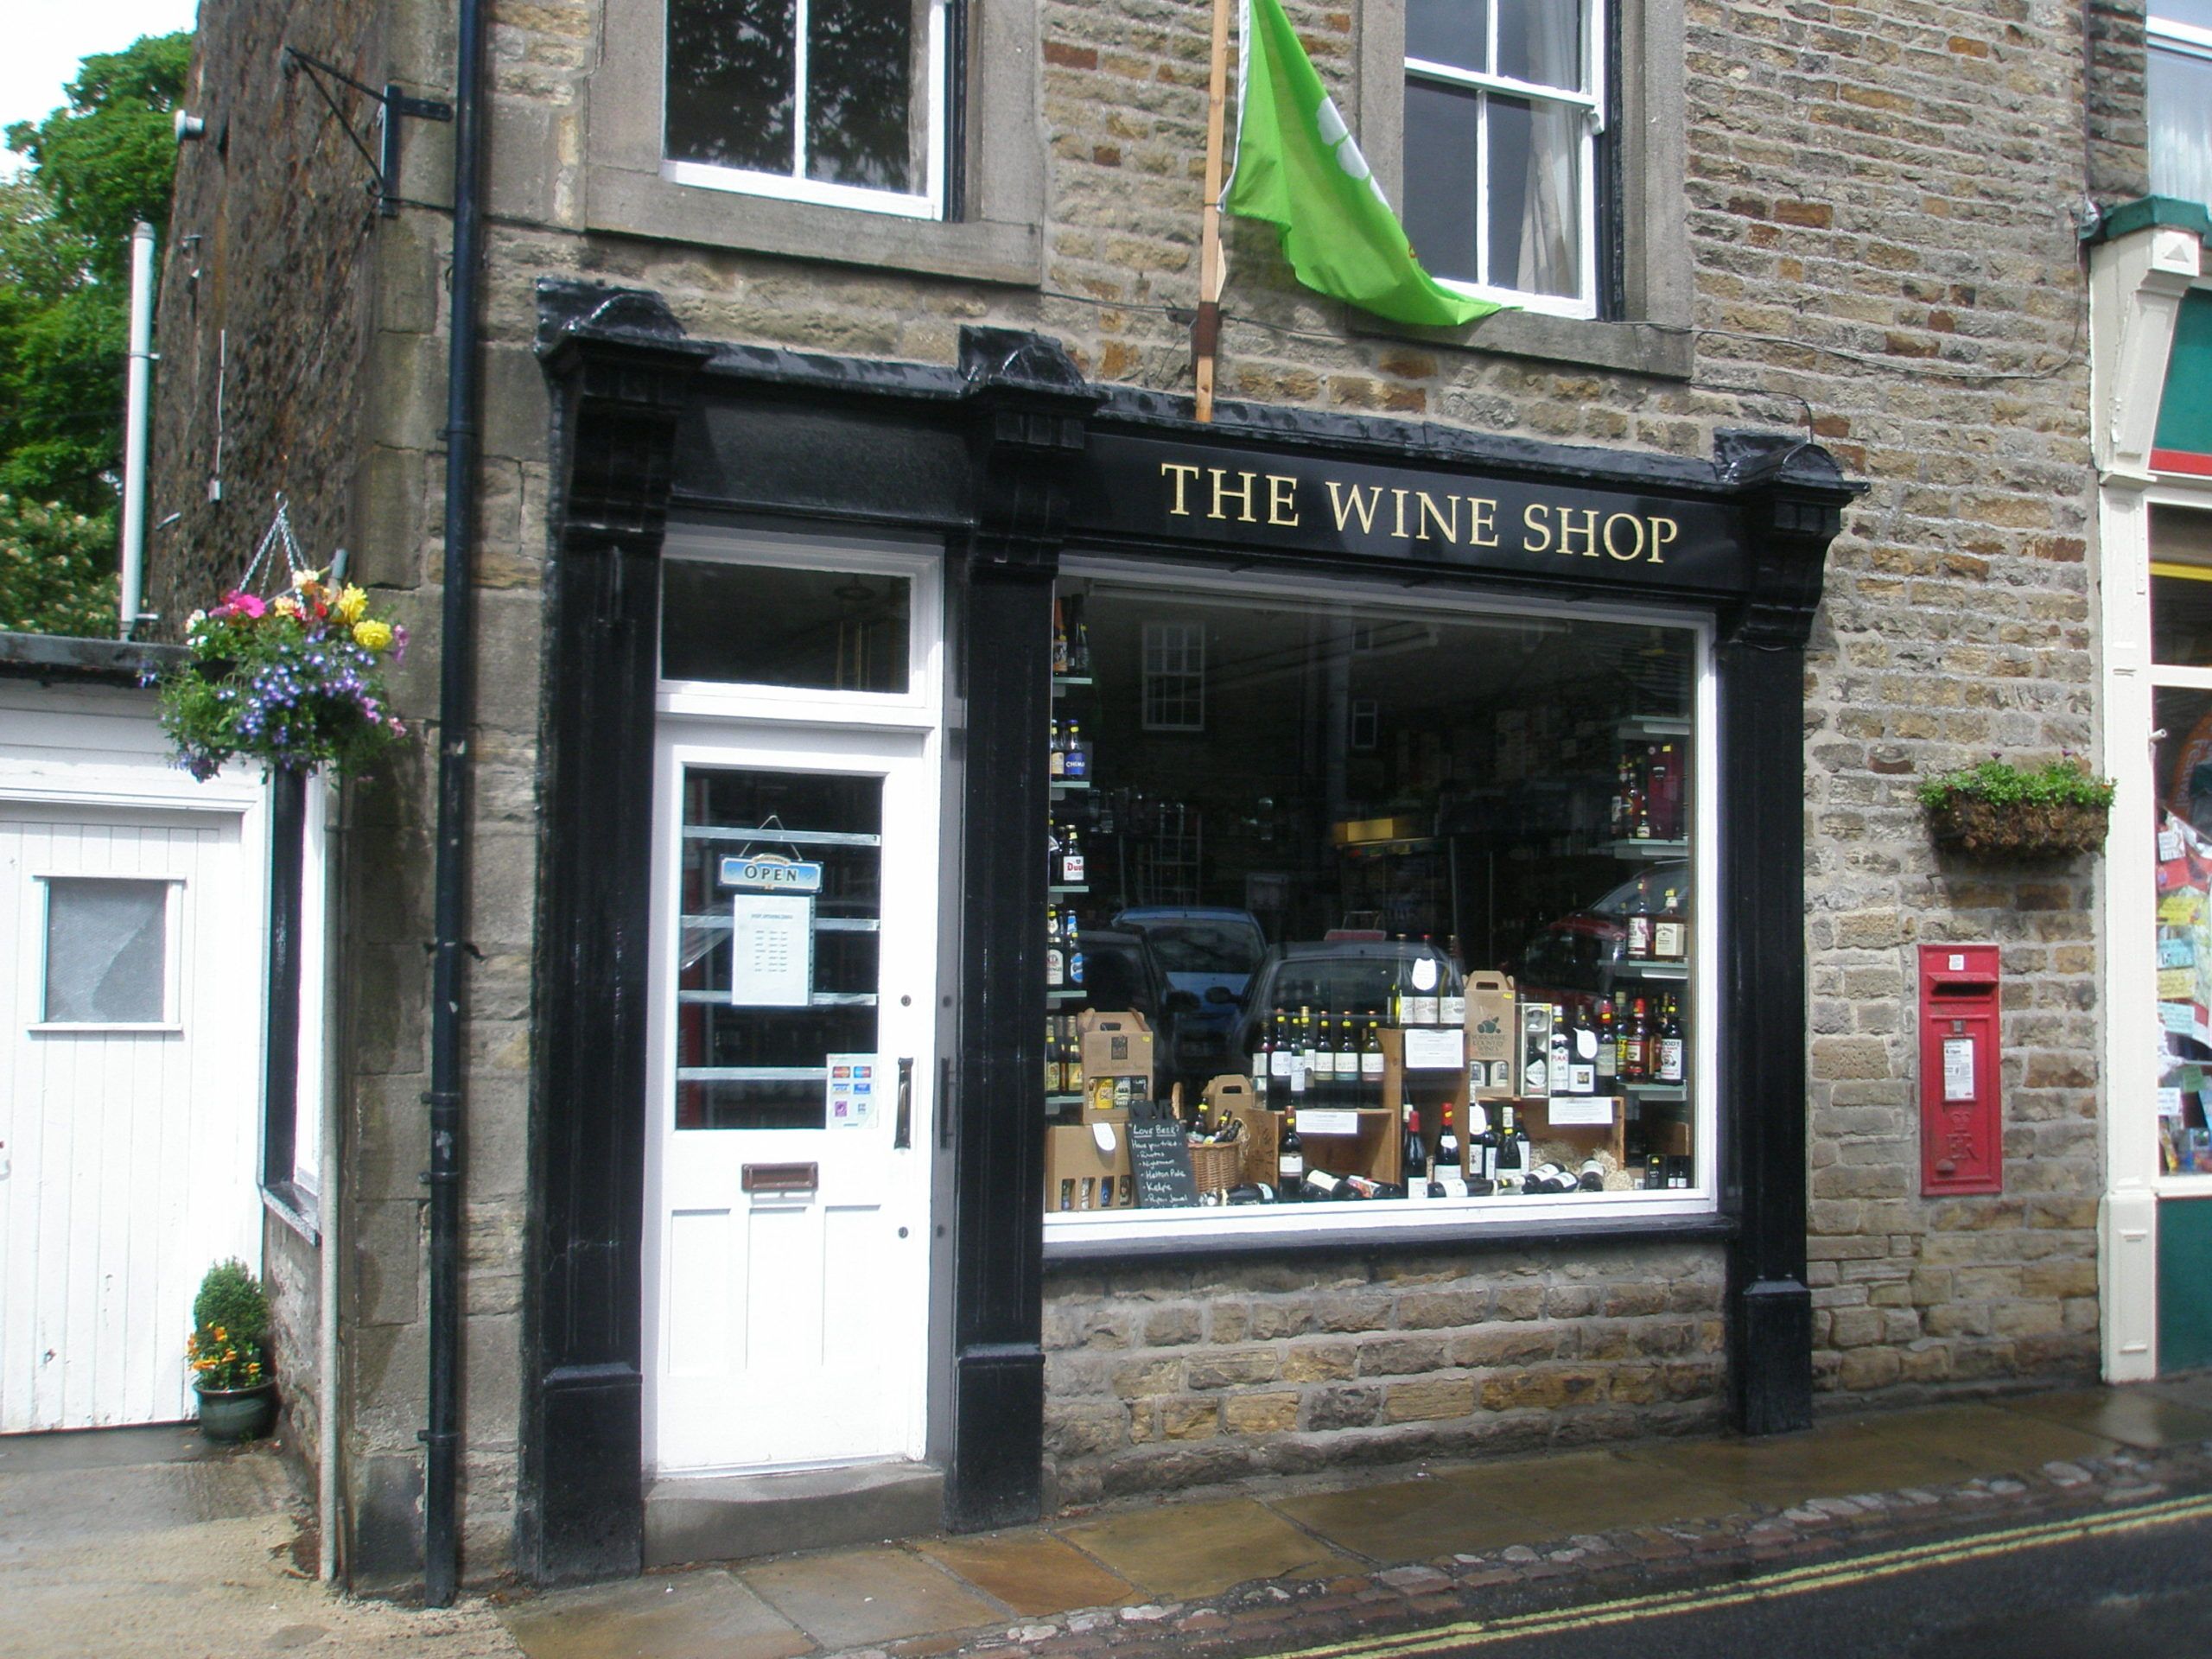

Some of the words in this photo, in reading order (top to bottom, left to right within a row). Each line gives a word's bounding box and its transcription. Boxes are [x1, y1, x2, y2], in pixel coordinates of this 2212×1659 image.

[1160, 462, 1300, 527] THE
[1325, 480, 1500, 548] WINE
[1522, 503, 1678, 564] SHOP
[744, 865, 797, 881] OPEN
